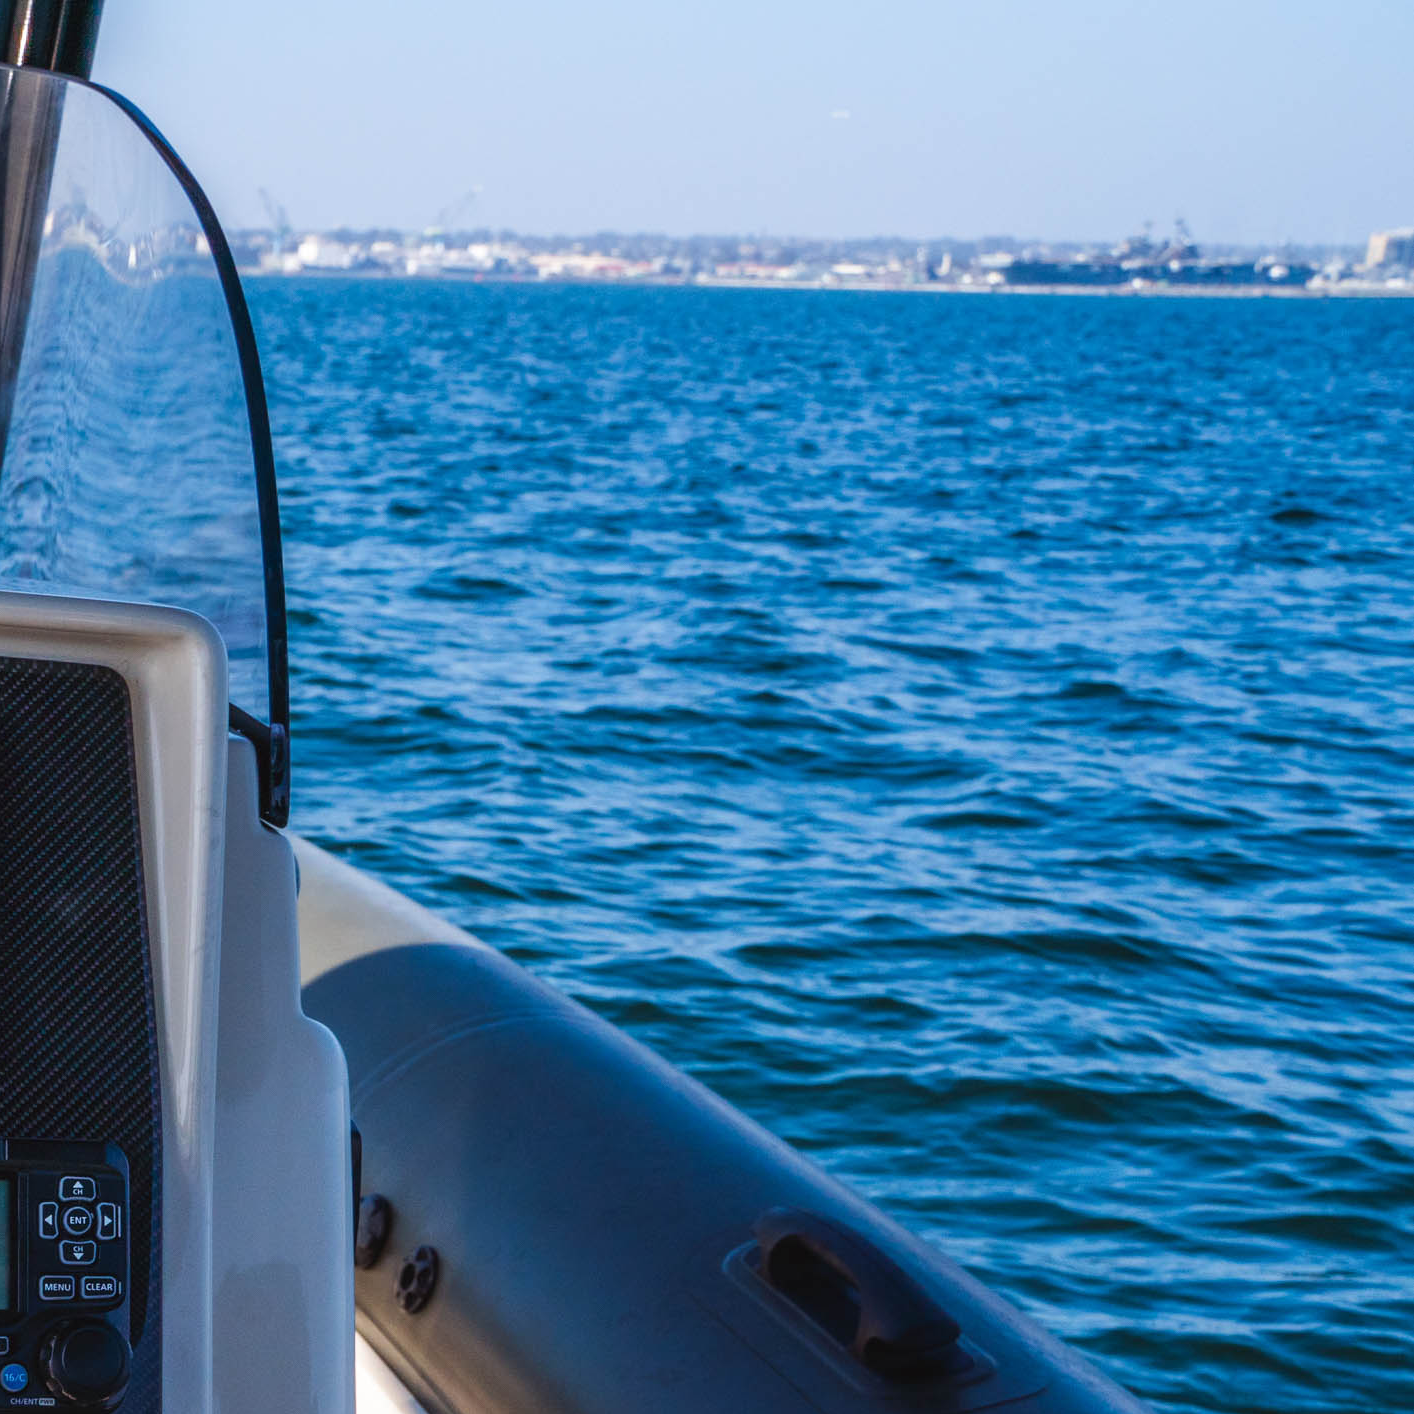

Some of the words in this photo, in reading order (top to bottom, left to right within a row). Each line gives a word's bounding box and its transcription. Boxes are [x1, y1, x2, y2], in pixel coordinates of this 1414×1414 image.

[72, 1188, 84, 1196] CH
[69, 1216, 88, 1225] ENT
[72, 1245, 84, 1253] CH
[44, 1282, 71, 1292] MENU
[85, 1282, 114, 1292] CLEAR
[4, 1373, 26, 1383] 16/C
[10, 1397, 39, 1407] CH/ENT
